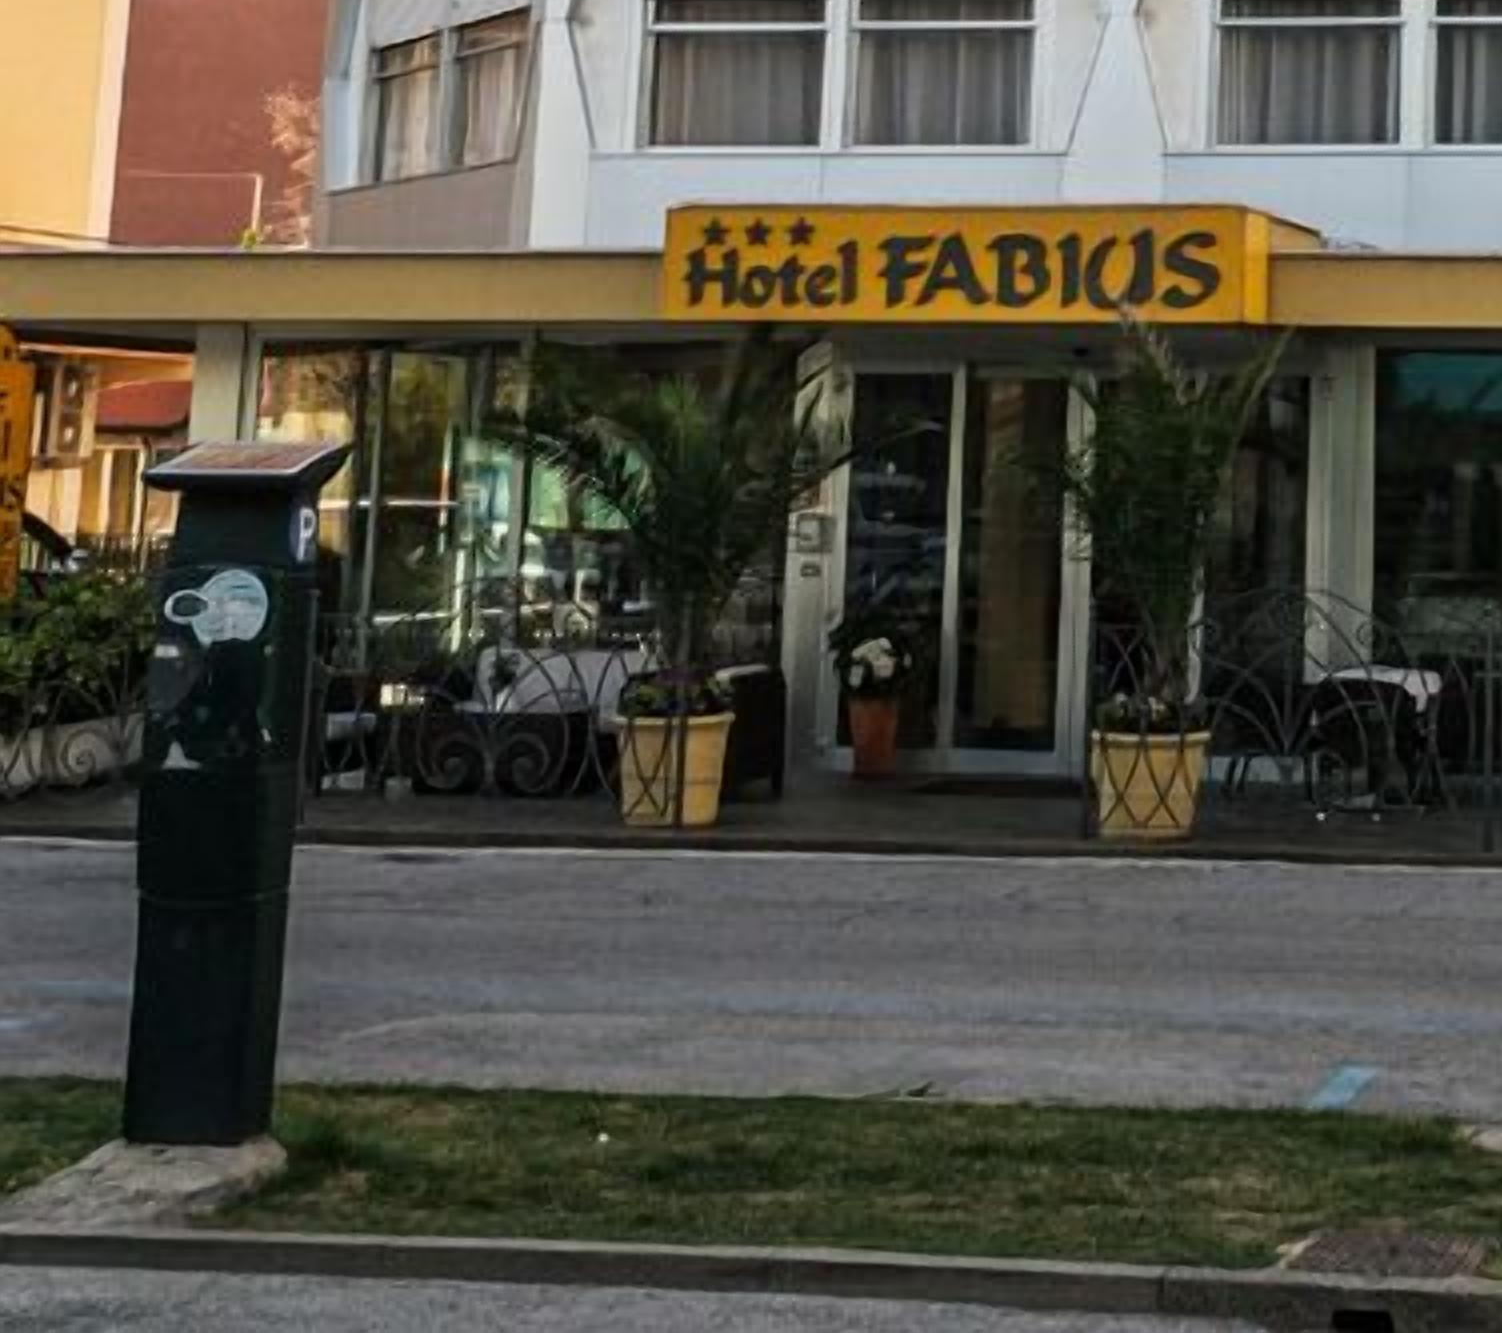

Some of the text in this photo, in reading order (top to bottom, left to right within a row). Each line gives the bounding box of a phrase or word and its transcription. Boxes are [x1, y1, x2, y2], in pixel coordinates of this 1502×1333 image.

[684, 228, 1222, 310] Hotel FABIUS
[297, 507, 316, 561] P
